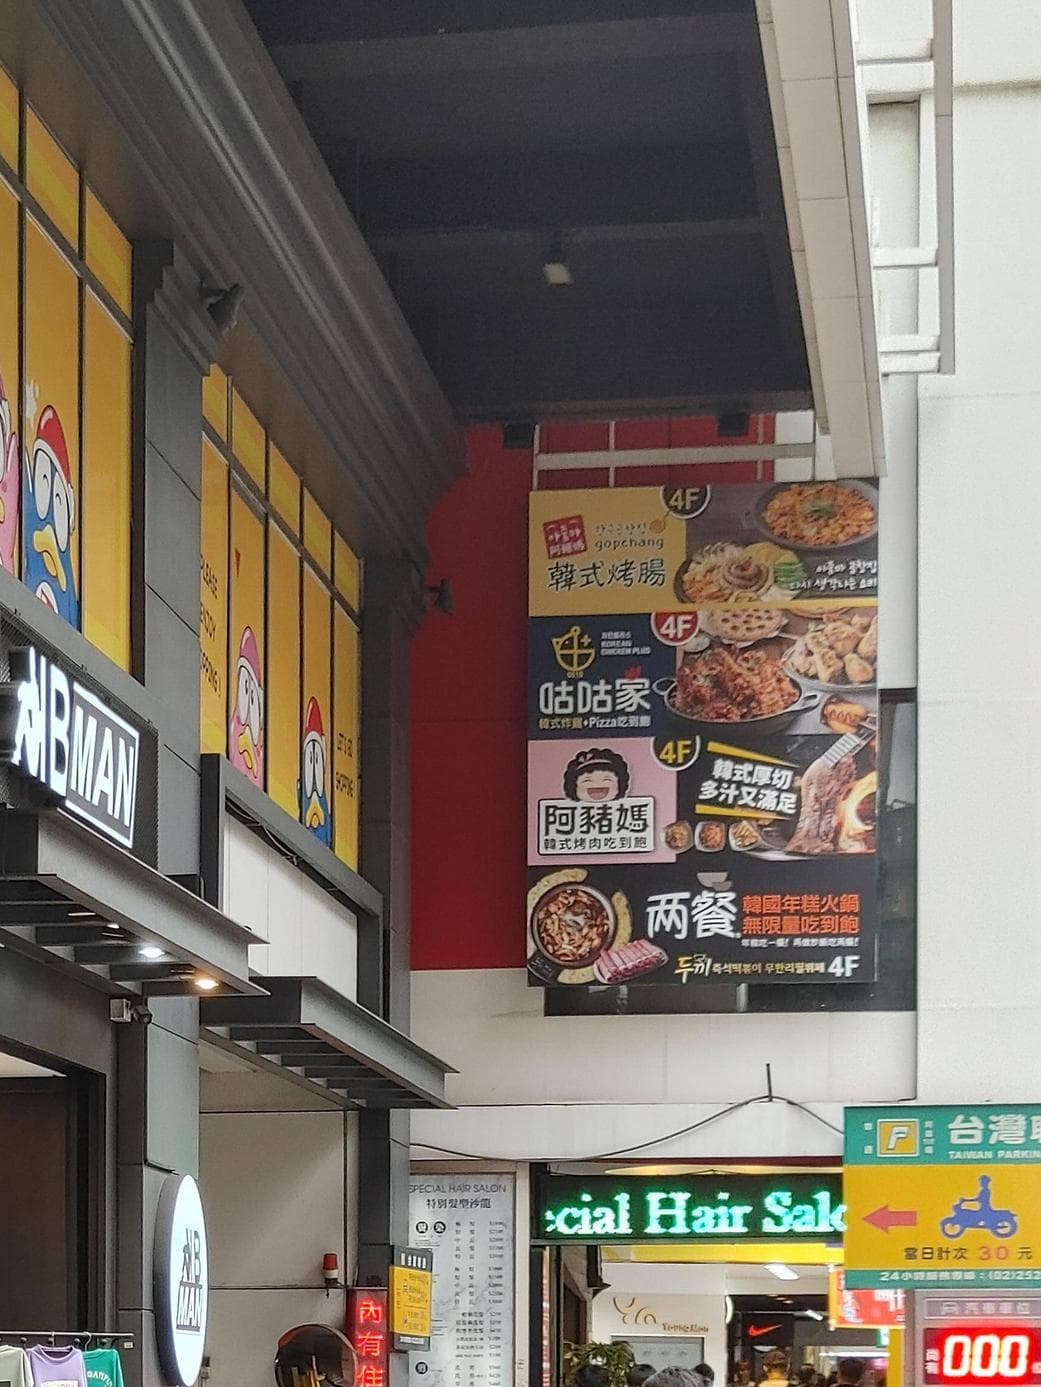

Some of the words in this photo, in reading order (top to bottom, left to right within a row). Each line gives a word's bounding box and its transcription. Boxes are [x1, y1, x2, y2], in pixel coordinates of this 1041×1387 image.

[668, 487, 700, 511] 4F
[595, 538, 664, 552] gopchang
[548, 558, 666, 592] 韓式烤腸
[660, 613, 692, 637] 4F
[540, 678, 651, 714] 咕咕家
[659, 741, 691, 764] 4F
[712, 758, 794, 790] 韓式厚切
[698, 780, 798, 814] 多汁又滿足
[544, 803, 649, 836] 阿豬媽
[544, 837, 647, 850] 韓式烤肉吃到飽
[742, 894, 859, 914] 韓國年糕火鍋
[742, 915, 859, 935] 無限量吃到飽
[827, 955, 860, 977] 4F
[409, 1185, 446, 1194] SPECIAL
[449, 1184, 471, 1193] HAIR
[473, 1184, 506, 1193] SALON
[644, 1192, 753, 1234] Hair
[978, 1246, 1010, 1261] 30
[1017, 1246, 1033, 1260] 元
[942, 1335, 1030, 1377] 000
